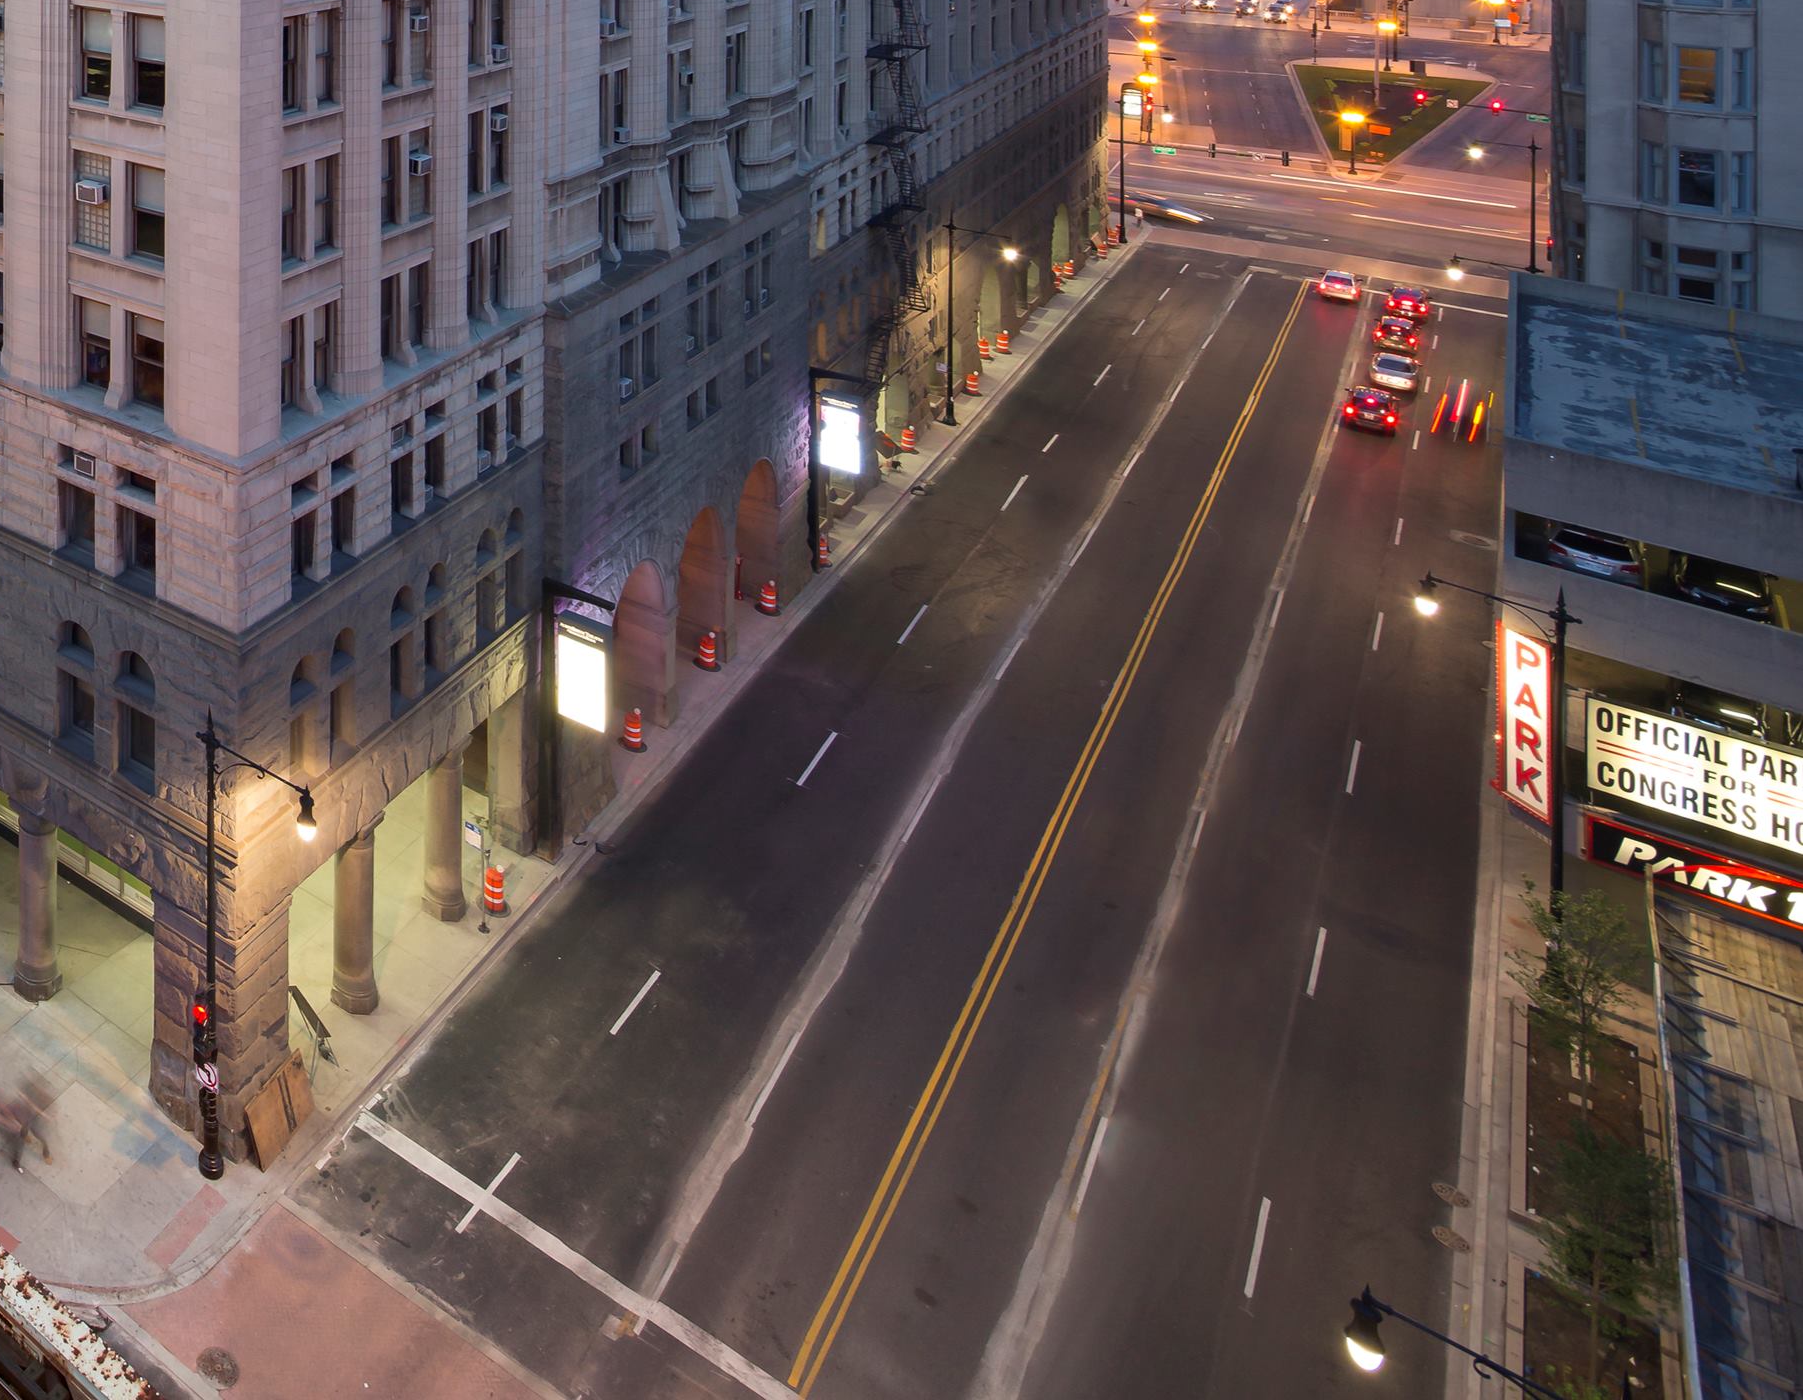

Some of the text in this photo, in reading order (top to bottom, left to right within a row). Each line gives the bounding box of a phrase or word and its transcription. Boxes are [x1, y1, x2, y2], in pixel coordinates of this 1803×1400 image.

[1514, 640, 1544, 804] PARK
[1596, 707, 1803, 787] OFFICIAL PAR
[1597, 761, 1757, 831] CONGRESS
[1703, 769, 1756, 797] FOR
[1613, 837, 1777, 913] PARK
